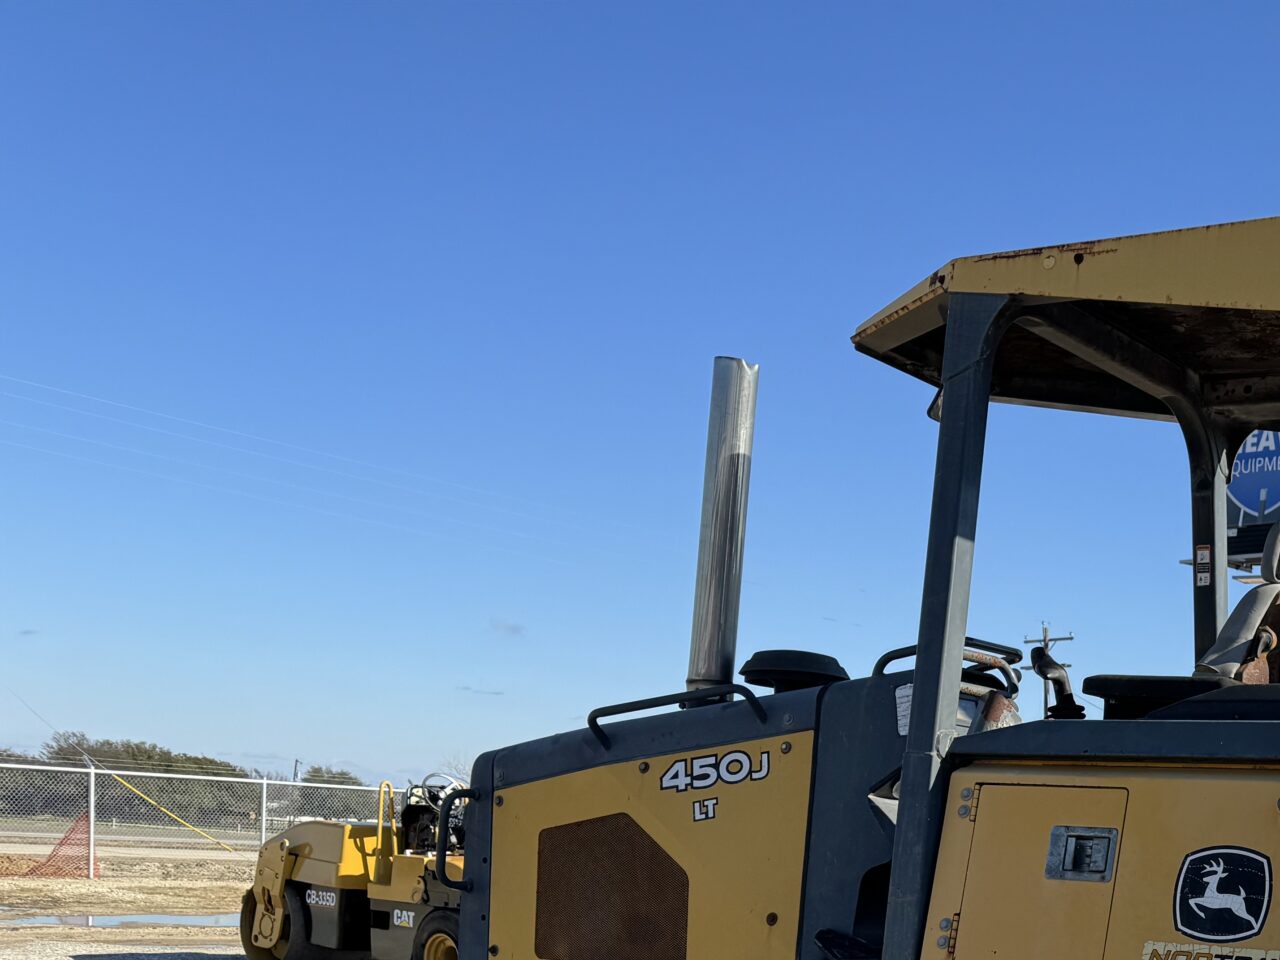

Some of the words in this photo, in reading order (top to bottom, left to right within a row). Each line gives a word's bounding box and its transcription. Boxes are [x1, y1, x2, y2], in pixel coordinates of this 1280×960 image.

[660, 750, 770, 792] 450J
[693, 797, 718, 821] LT
[306, 890, 336, 906] CB-335D
[394, 909, 415, 927] CAT
